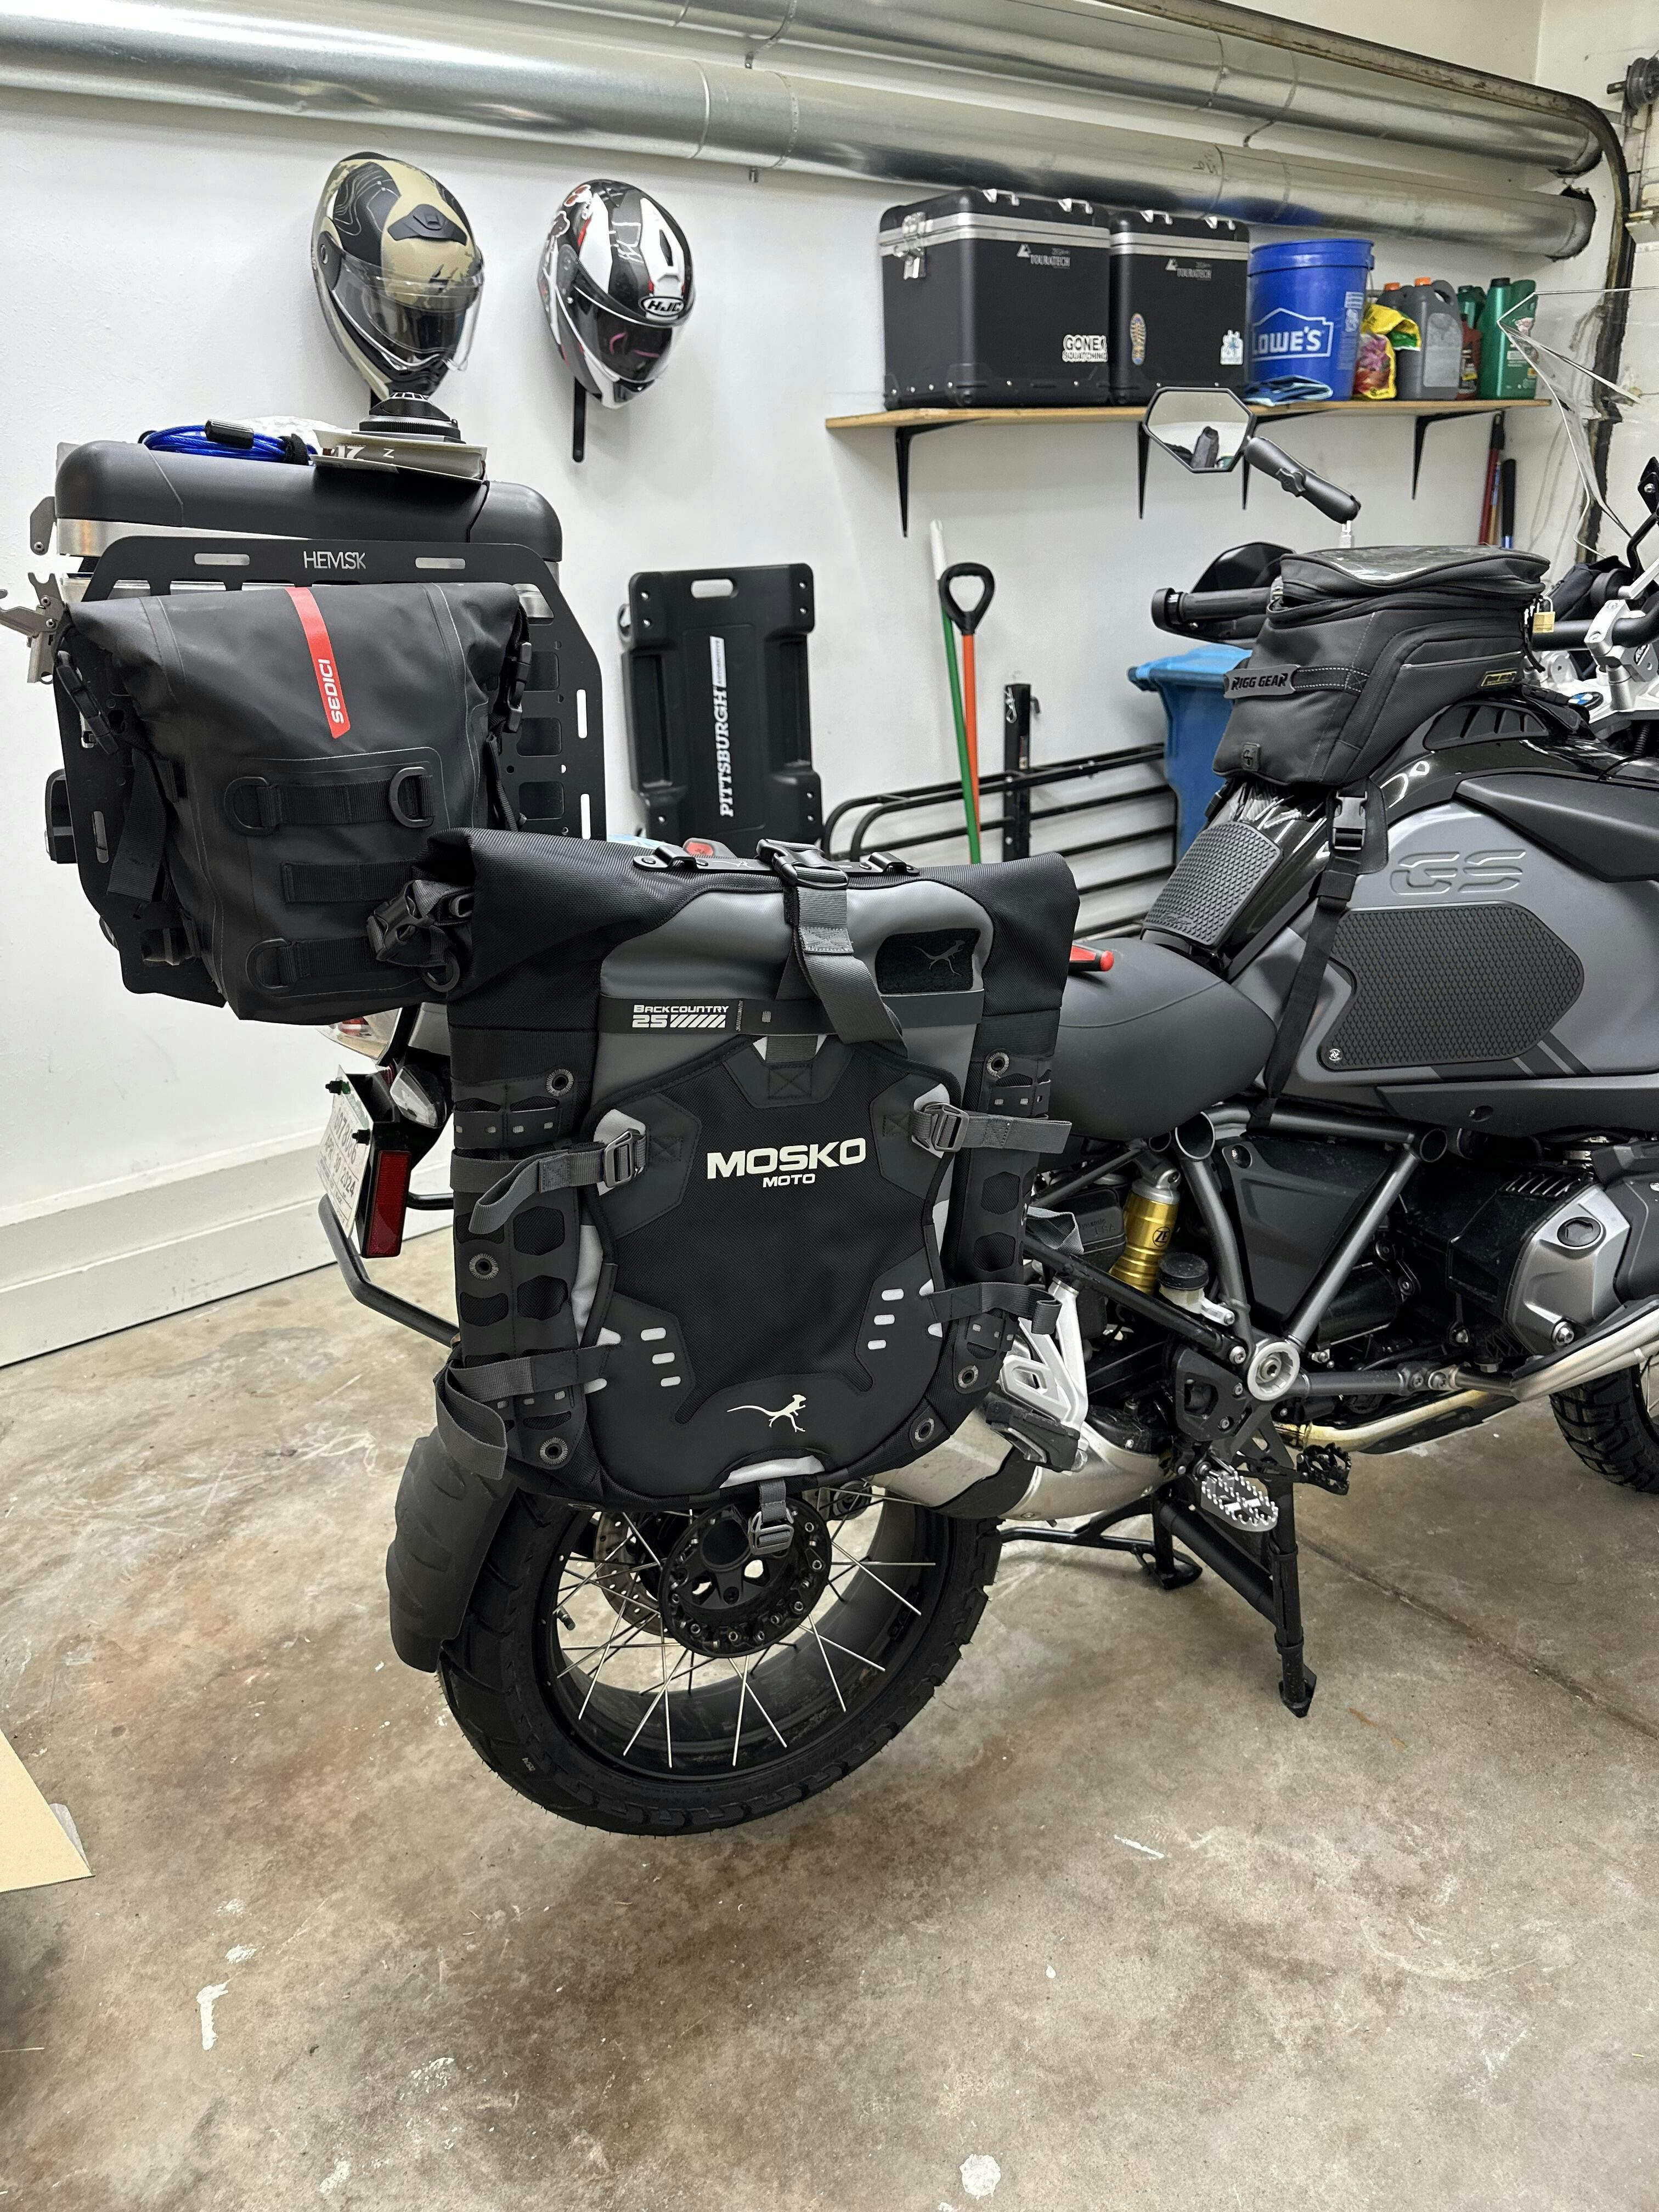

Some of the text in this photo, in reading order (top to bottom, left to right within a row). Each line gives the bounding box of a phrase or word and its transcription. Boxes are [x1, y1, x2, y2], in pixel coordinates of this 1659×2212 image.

[647, 300, 681, 312] HJC
[1065, 337, 1099, 351] GONE
[1252, 326, 1322, 355] LOWE'S
[303, 550, 366, 570] HEMSK
[1231, 673, 1289, 690] RIGG GEAR
[318, 658, 345, 724] SEDICI
[713, 686, 734, 817] PITTSBURGH
[1390, 849, 1526, 896] GS
[633, 1005, 730, 1013] BACKCOUNTRY
[632, 1014, 668, 1028] 25
[707, 1137, 866, 1180] MOSKO
[340, 1167, 356, 1197] 2024
[763, 1173, 816, 1188] MOTO
[1154, 1229, 1170, 1244] ZF
